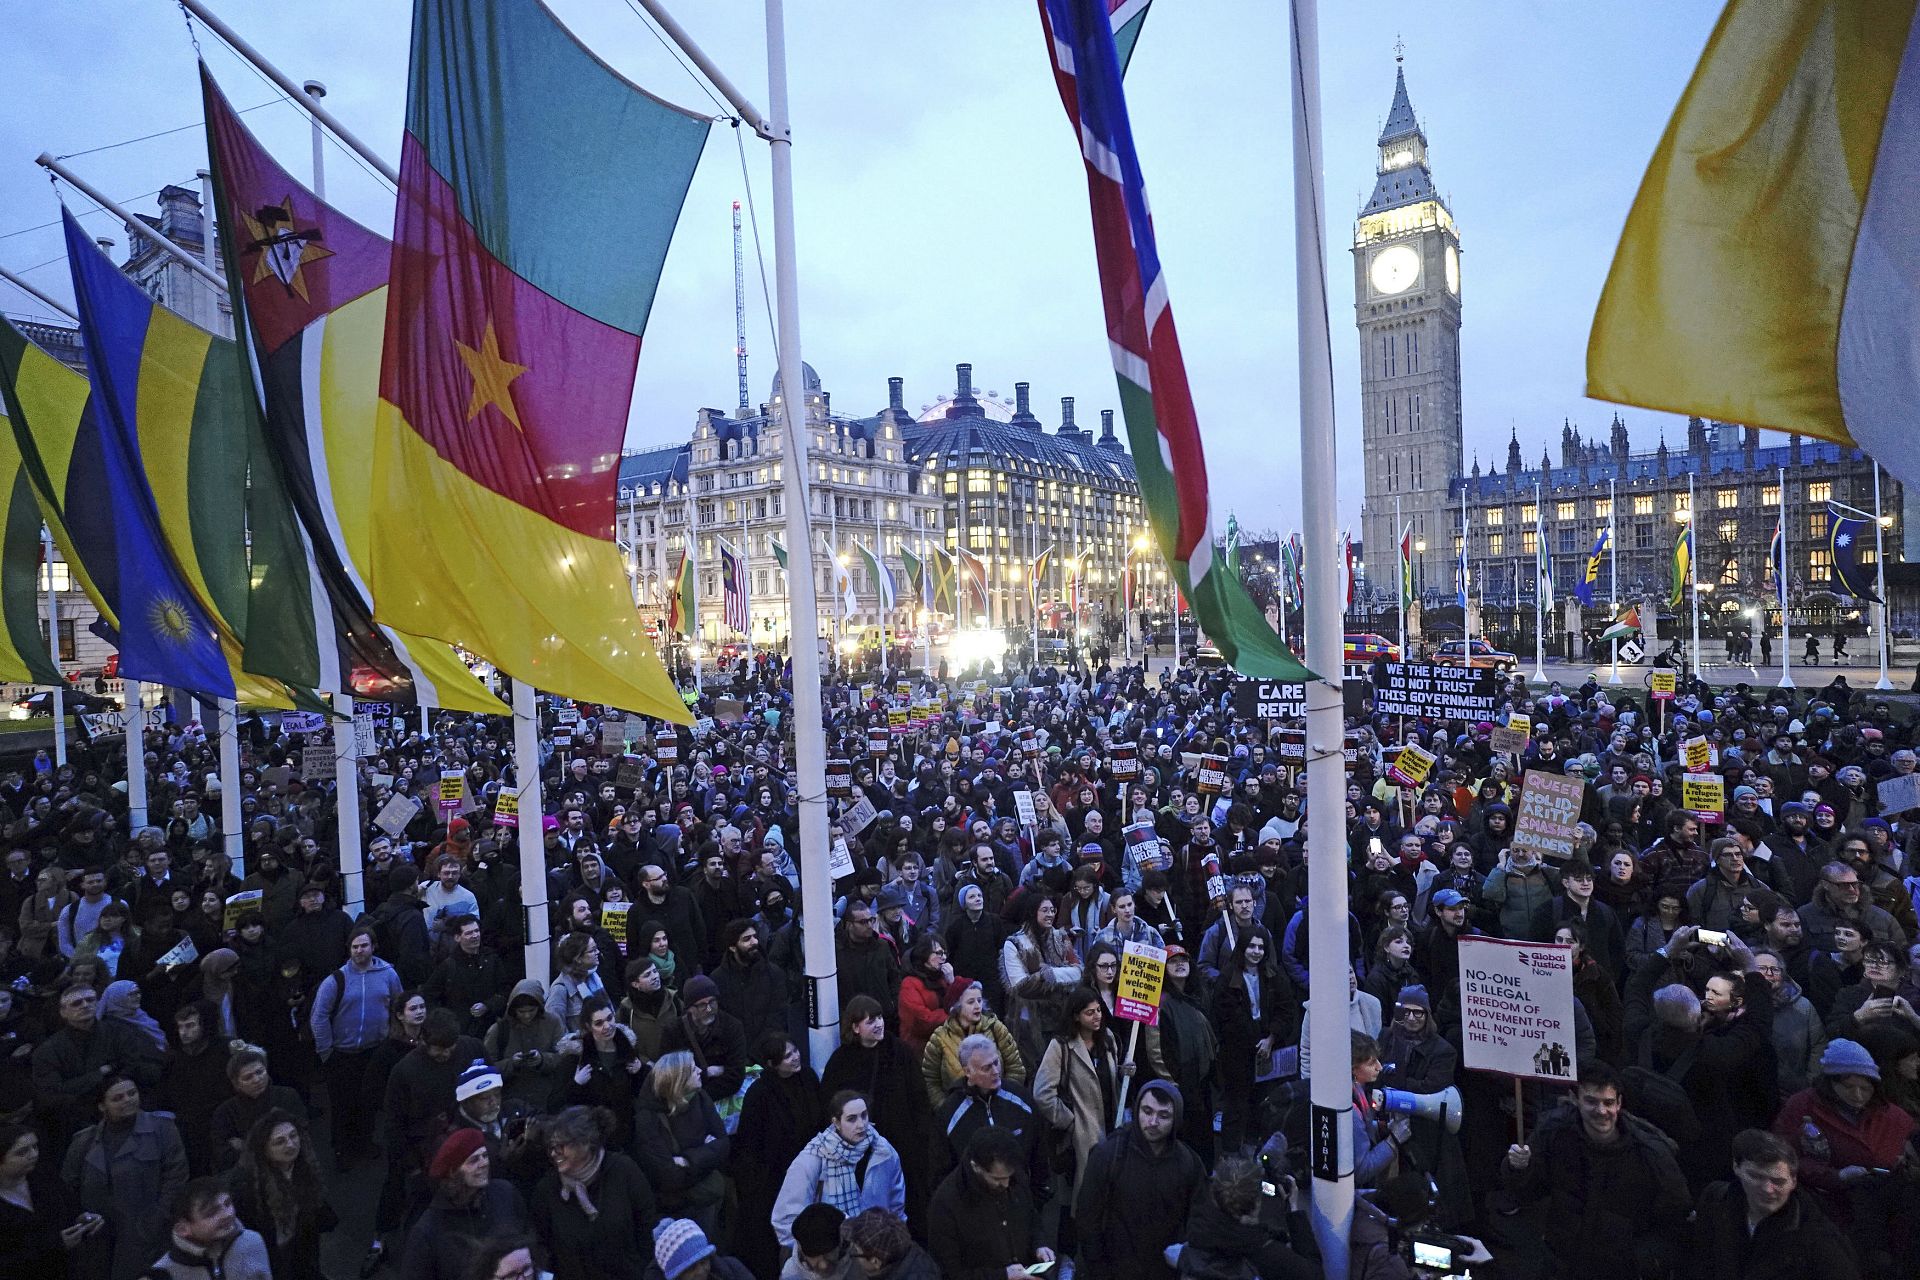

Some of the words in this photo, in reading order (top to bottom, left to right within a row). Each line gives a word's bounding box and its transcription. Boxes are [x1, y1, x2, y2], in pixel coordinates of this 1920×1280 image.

[1386, 663, 1404, 675] WE
[1407, 665, 1430, 677] THE
[1433, 666, 1482, 680] PEOPLE
[1258, 684, 1304, 699] CARE
[1391, 677, 1405, 688] DO
[1408, 678, 1431, 690] NOT
[1435, 680, 1475, 693] TRUST
[1379, 689, 1406, 701] THIS
[1409, 691, 1495, 708] GOVERNMENT
[353, 702, 391, 715] FUGEES
[1257, 702, 1308, 718] REFUG
[1378, 702, 1421, 716] ENOUGH
[1425, 706, 1441, 718] IS
[1445, 708, 1496, 721] ENOUGH
[146, 710, 162, 725] IS
[283, 721, 304, 731] LEGAL
[1281, 743, 1304, 751] REFUGEES
[1112, 759, 1136, 767] REFUGEES
[1407, 749, 1428, 765] Migrants
[1407, 756, 1426, 771] refugees
[1200, 768, 1224, 778] REFUGEES
[1402, 759, 1421, 774] welcome
[1403, 766, 1413, 775] here
[827, 780, 850, 788] WELCOME
[1199, 776, 1223, 786] WELCOME
[1528, 774, 1581, 799] QUEER
[1688, 782, 1718, 791] Migrants
[1523, 790, 1579, 811] SOLID-
[1689, 795, 1717, 804] welcome
[1692, 788, 1721, 798] refugees
[855, 800, 875, 823] BILL
[1523, 803, 1575, 824] ARITY
[1131, 840, 1159, 854] REFUGEES
[1513, 830, 1574, 855] BORDERS
[1133, 848, 1162, 863] WELCOME
[610, 919, 627, 927] refug
[1128, 956, 1160, 972] Migrants
[1531, 953, 1566, 962] Global
[1531, 960, 1566, 970] Justice
[1123, 966, 1128, 974] &
[1131, 969, 1161, 983] refugees
[1466, 969, 1521, 987] NO-ONE
[1532, 968, 1552, 976] Now
[1125, 979, 1156, 992] welcome
[1466, 982, 1477, 992] IS
[1481, 985, 1532, 1001] ILLEGAL
[1132, 988, 1148, 1000] here
[1467, 995, 1520, 1013] FREEDOM
[1524, 1005, 1540, 1014] OF
[1468, 1008, 1533, 1025] MOVEMENT
[1537, 1019, 1561, 1029] FOR
[1494, 1024, 1517, 1036] NOT
[1520, 1029, 1546, 1039] JUST
[1469, 1032, 1488, 1042] THE
[1492, 1035, 1508, 1047] 1%
[1321, 1115, 1329, 1171] NAMIBIA
